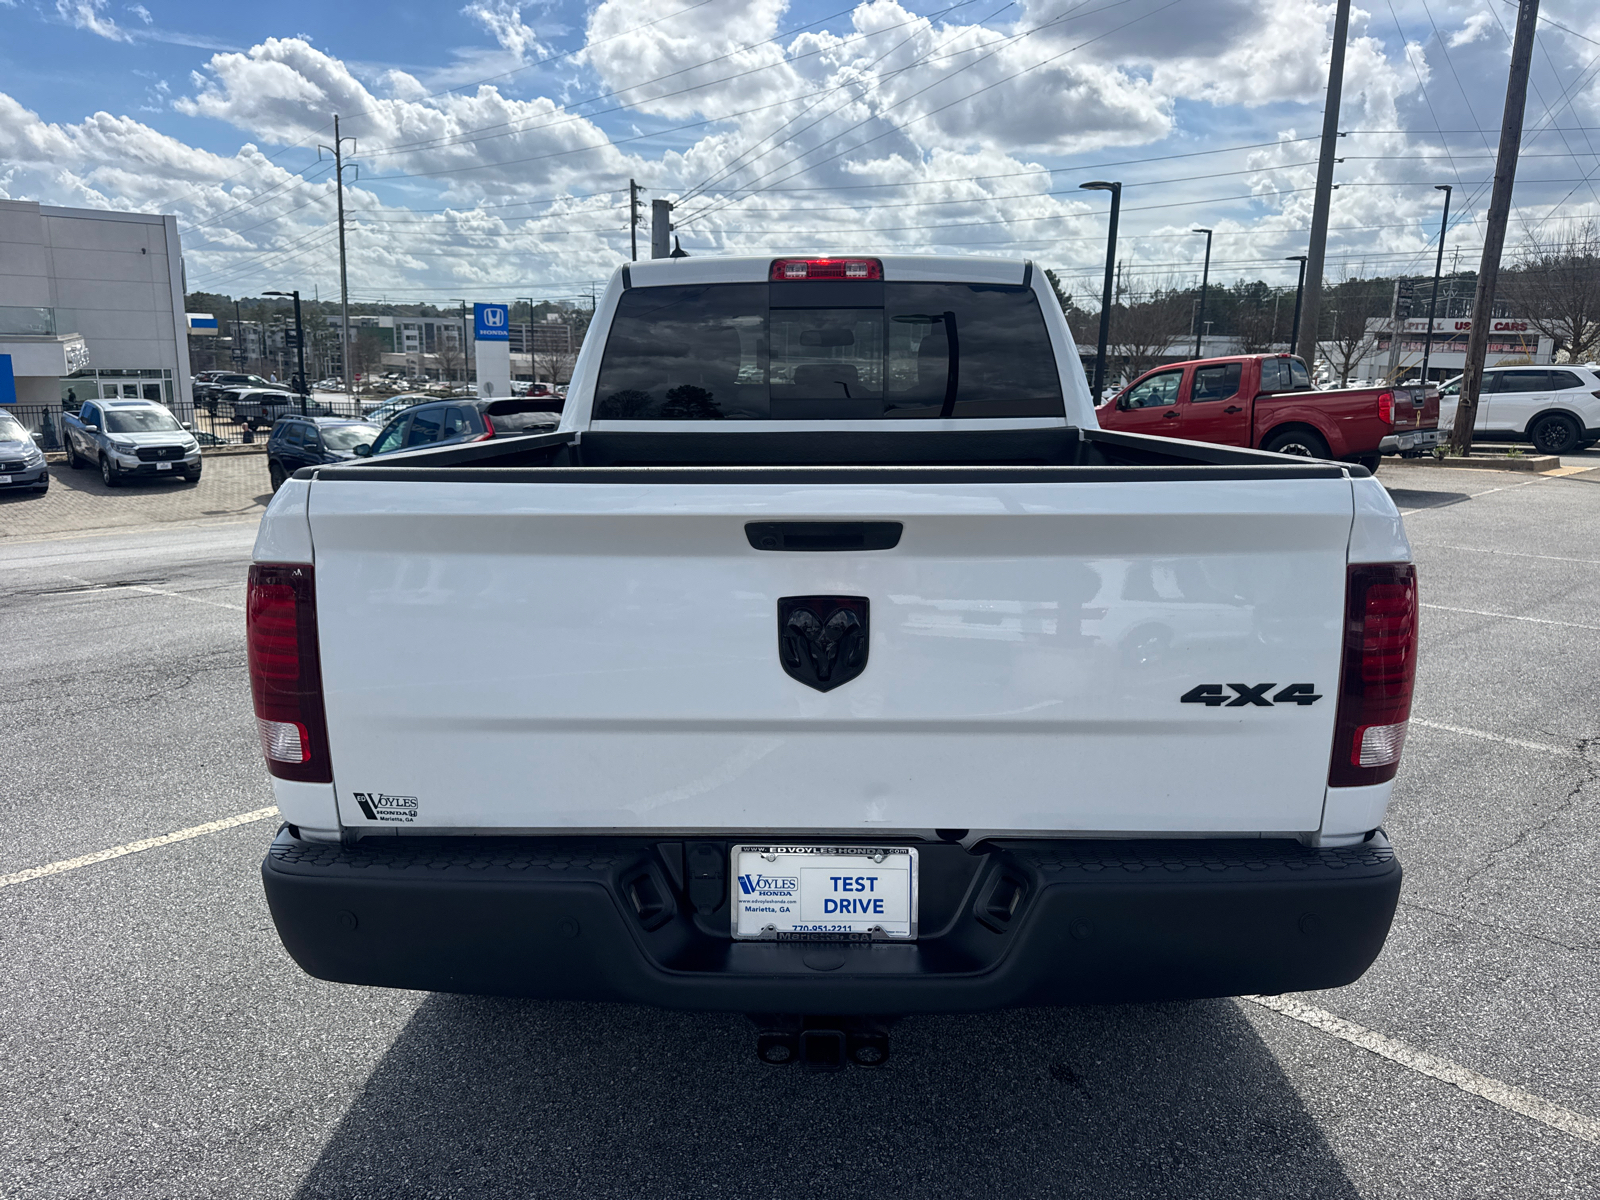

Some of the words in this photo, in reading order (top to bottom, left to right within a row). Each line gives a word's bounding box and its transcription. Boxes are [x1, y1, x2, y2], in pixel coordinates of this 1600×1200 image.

[1387, 321, 1444, 331] CPITL
[1494, 322, 1528, 331] CARS
[1180, 683, 1323, 707] 4X4
[366, 793, 417, 809] VOYLES
[745, 874, 796, 893] VOYLES
[830, 876, 878, 892] TEST
[824, 898, 884, 914] DRIVE
[779, 932, 844, 940] Marietta,
